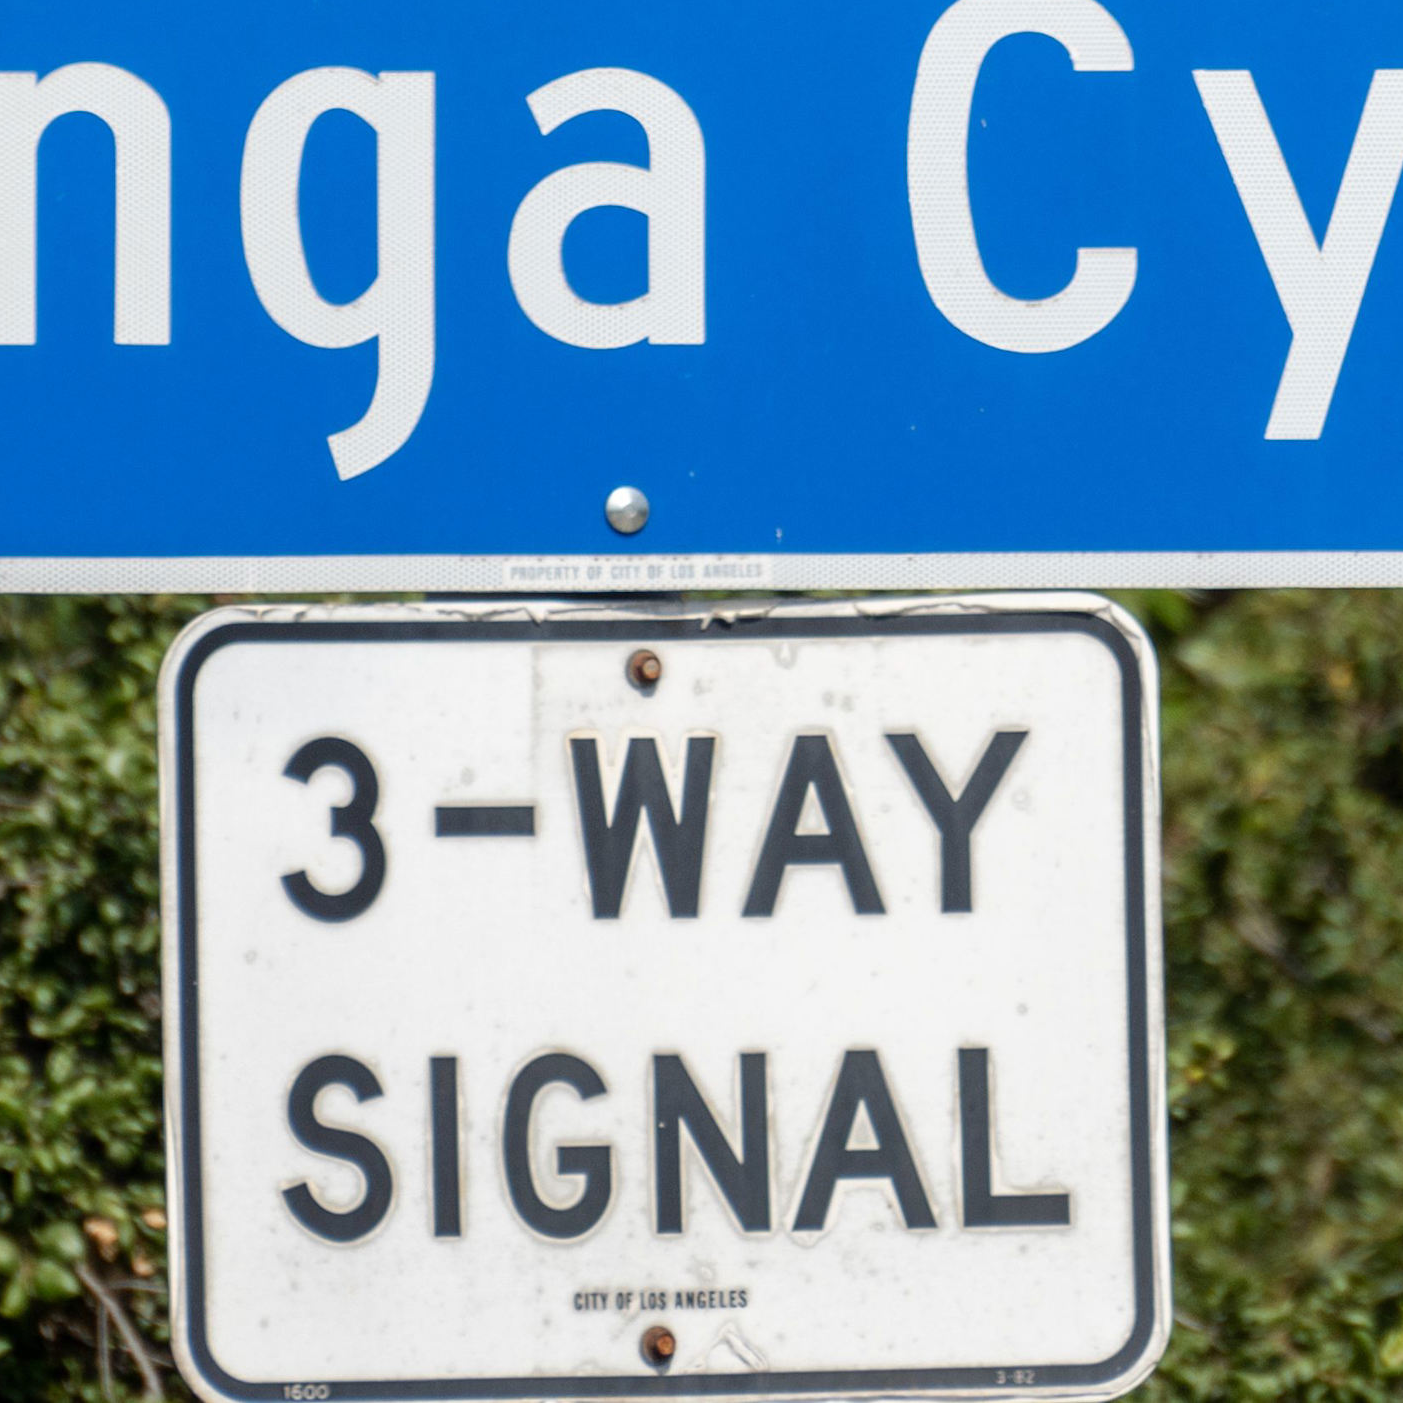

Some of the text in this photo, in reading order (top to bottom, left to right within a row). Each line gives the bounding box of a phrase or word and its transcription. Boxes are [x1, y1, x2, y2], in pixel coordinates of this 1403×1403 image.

[510, 563, 763, 581] PROPERTY OF CITY OF LOS ANGELES
[281, 731, 1030, 924] 3-WAY
[281, 1047, 1071, 1243] SIGNAL
[573, 1289, 748, 1311] CITY OF LOS ANGELES
[283, 1383, 331, 1401] 1600
